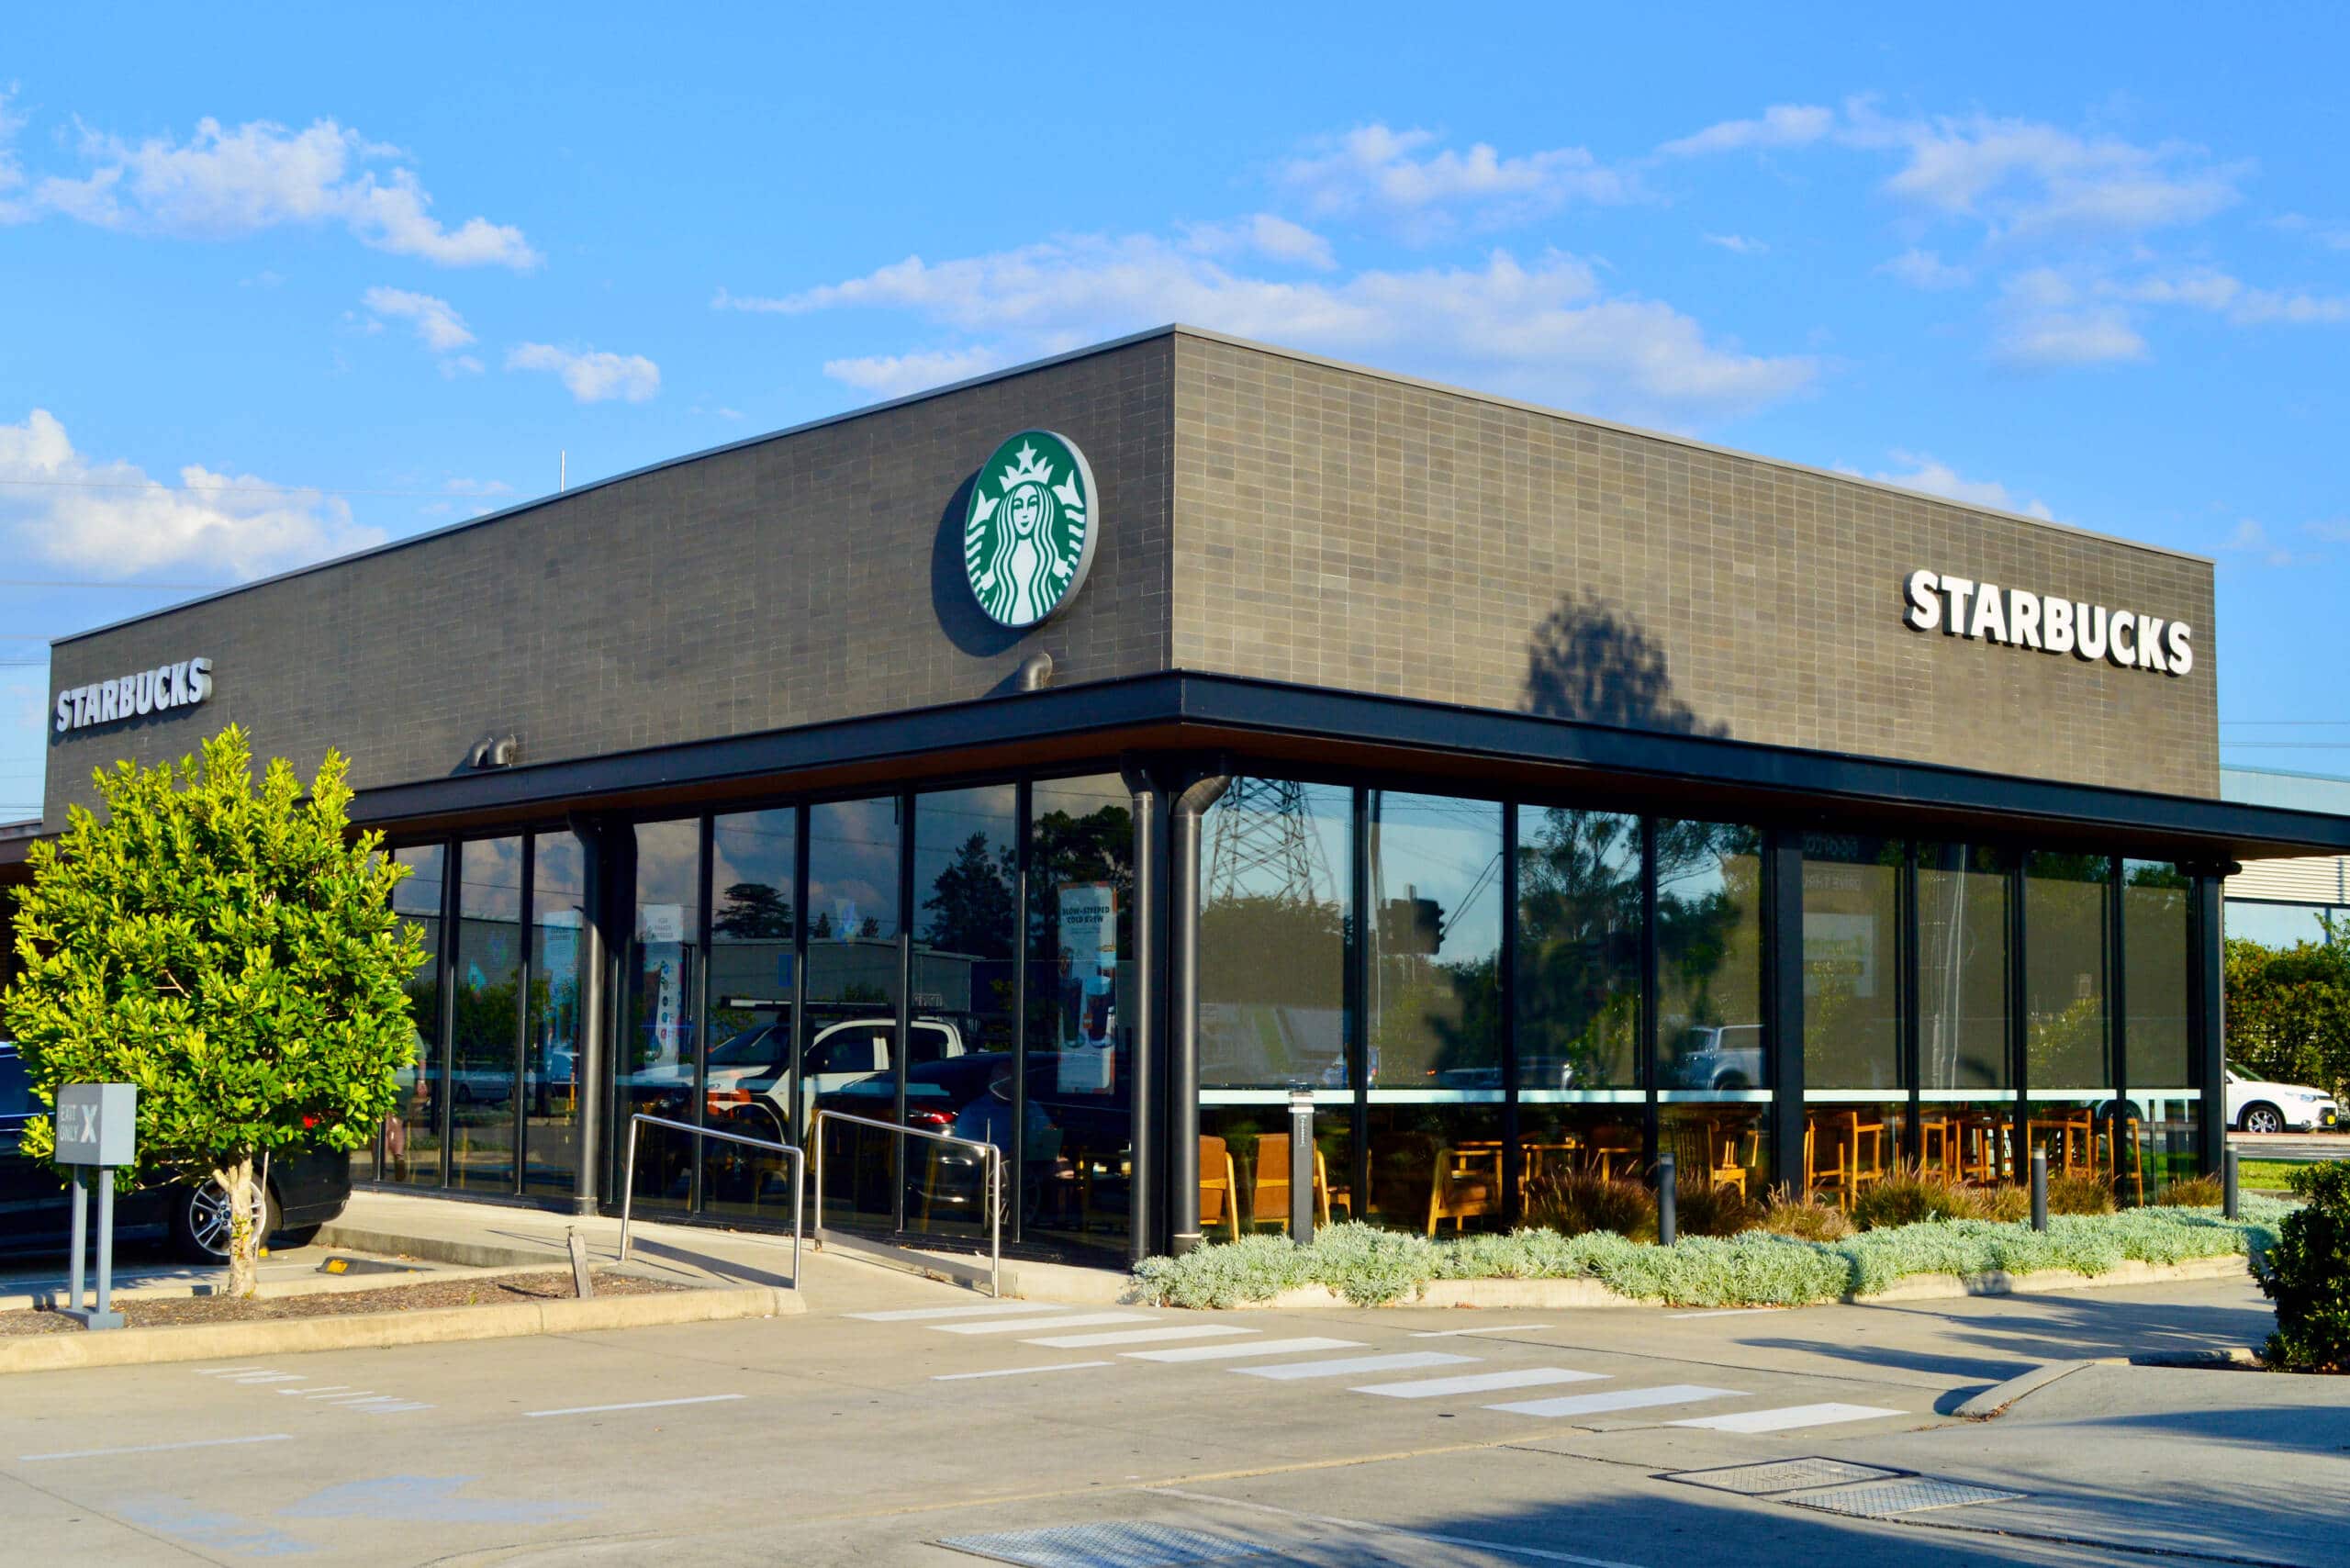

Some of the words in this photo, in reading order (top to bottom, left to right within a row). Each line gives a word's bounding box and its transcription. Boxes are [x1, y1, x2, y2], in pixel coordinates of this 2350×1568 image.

[1904, 569, 2192, 676] STARBUCKS
[57, 657, 212, 732] STARBUCKS
[60, 1123, 79, 1142] ONLY
[61, 1103, 77, 1122] EXIT
